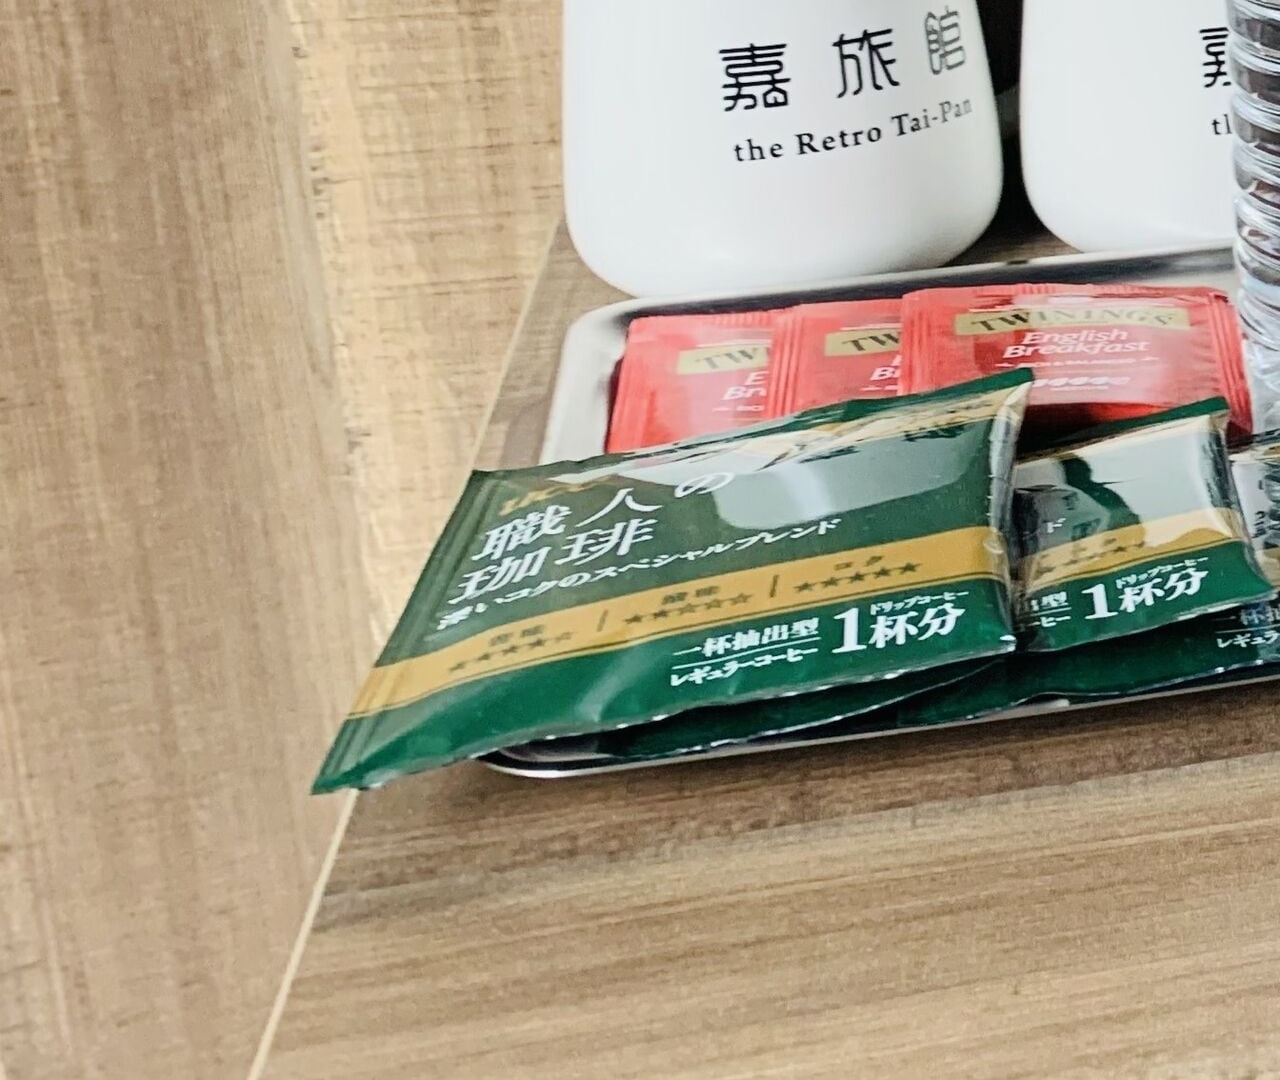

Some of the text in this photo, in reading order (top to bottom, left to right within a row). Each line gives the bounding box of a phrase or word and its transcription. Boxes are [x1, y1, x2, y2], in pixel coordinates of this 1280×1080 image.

[734, 98, 973, 161] the Retro Tai-Pan
[969, 307, 1178, 332] TWININGS
[1020, 328, 1129, 346] English
[1002, 340, 1150, 359] Breakfast
[471, 471, 735, 562] 職人の
[447, 518, 659, 606] 珈琲
[1080, 566, 1209, 620] 1杯分
[672, 617, 820, 658] 一杯抽出型
[832, 602, 966, 654] 1杯分
[669, 647, 819, 687] レギュラーコーヒー
